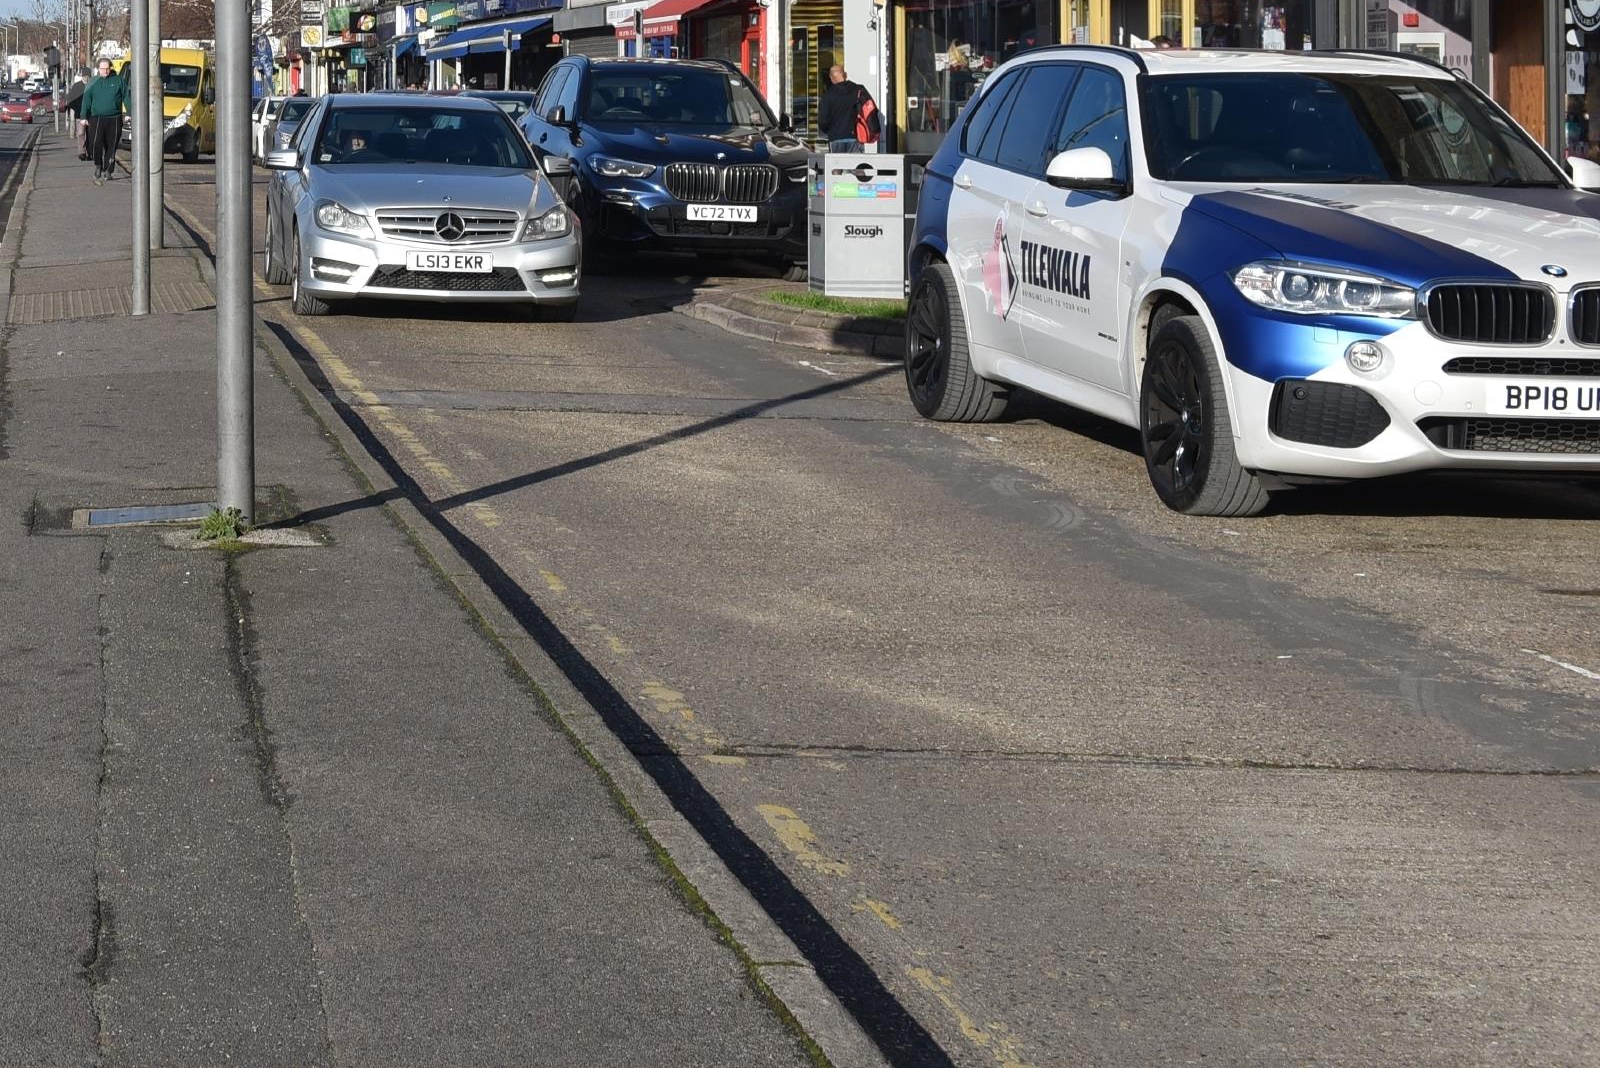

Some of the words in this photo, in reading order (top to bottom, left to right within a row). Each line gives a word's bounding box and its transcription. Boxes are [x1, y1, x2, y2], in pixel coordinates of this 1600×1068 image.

[692, 206, 724, 218] YC72
[728, 208, 751, 219] TVX
[844, 224, 883, 238] Slough
[416, 254, 450, 268] LS13
[455, 255, 484, 269] EKR
[1020, 240, 1091, 301] TILEWALA
[1043, 295, 1053, 305] LIFE
[1055, 298, 1061, 307] TO
[1062, 300, 1075, 311] YOUR
[1076, 304, 1091, 315] HOME
[1505, 385, 1569, 410] BP18
[1577, 387, 1600, 411] U
